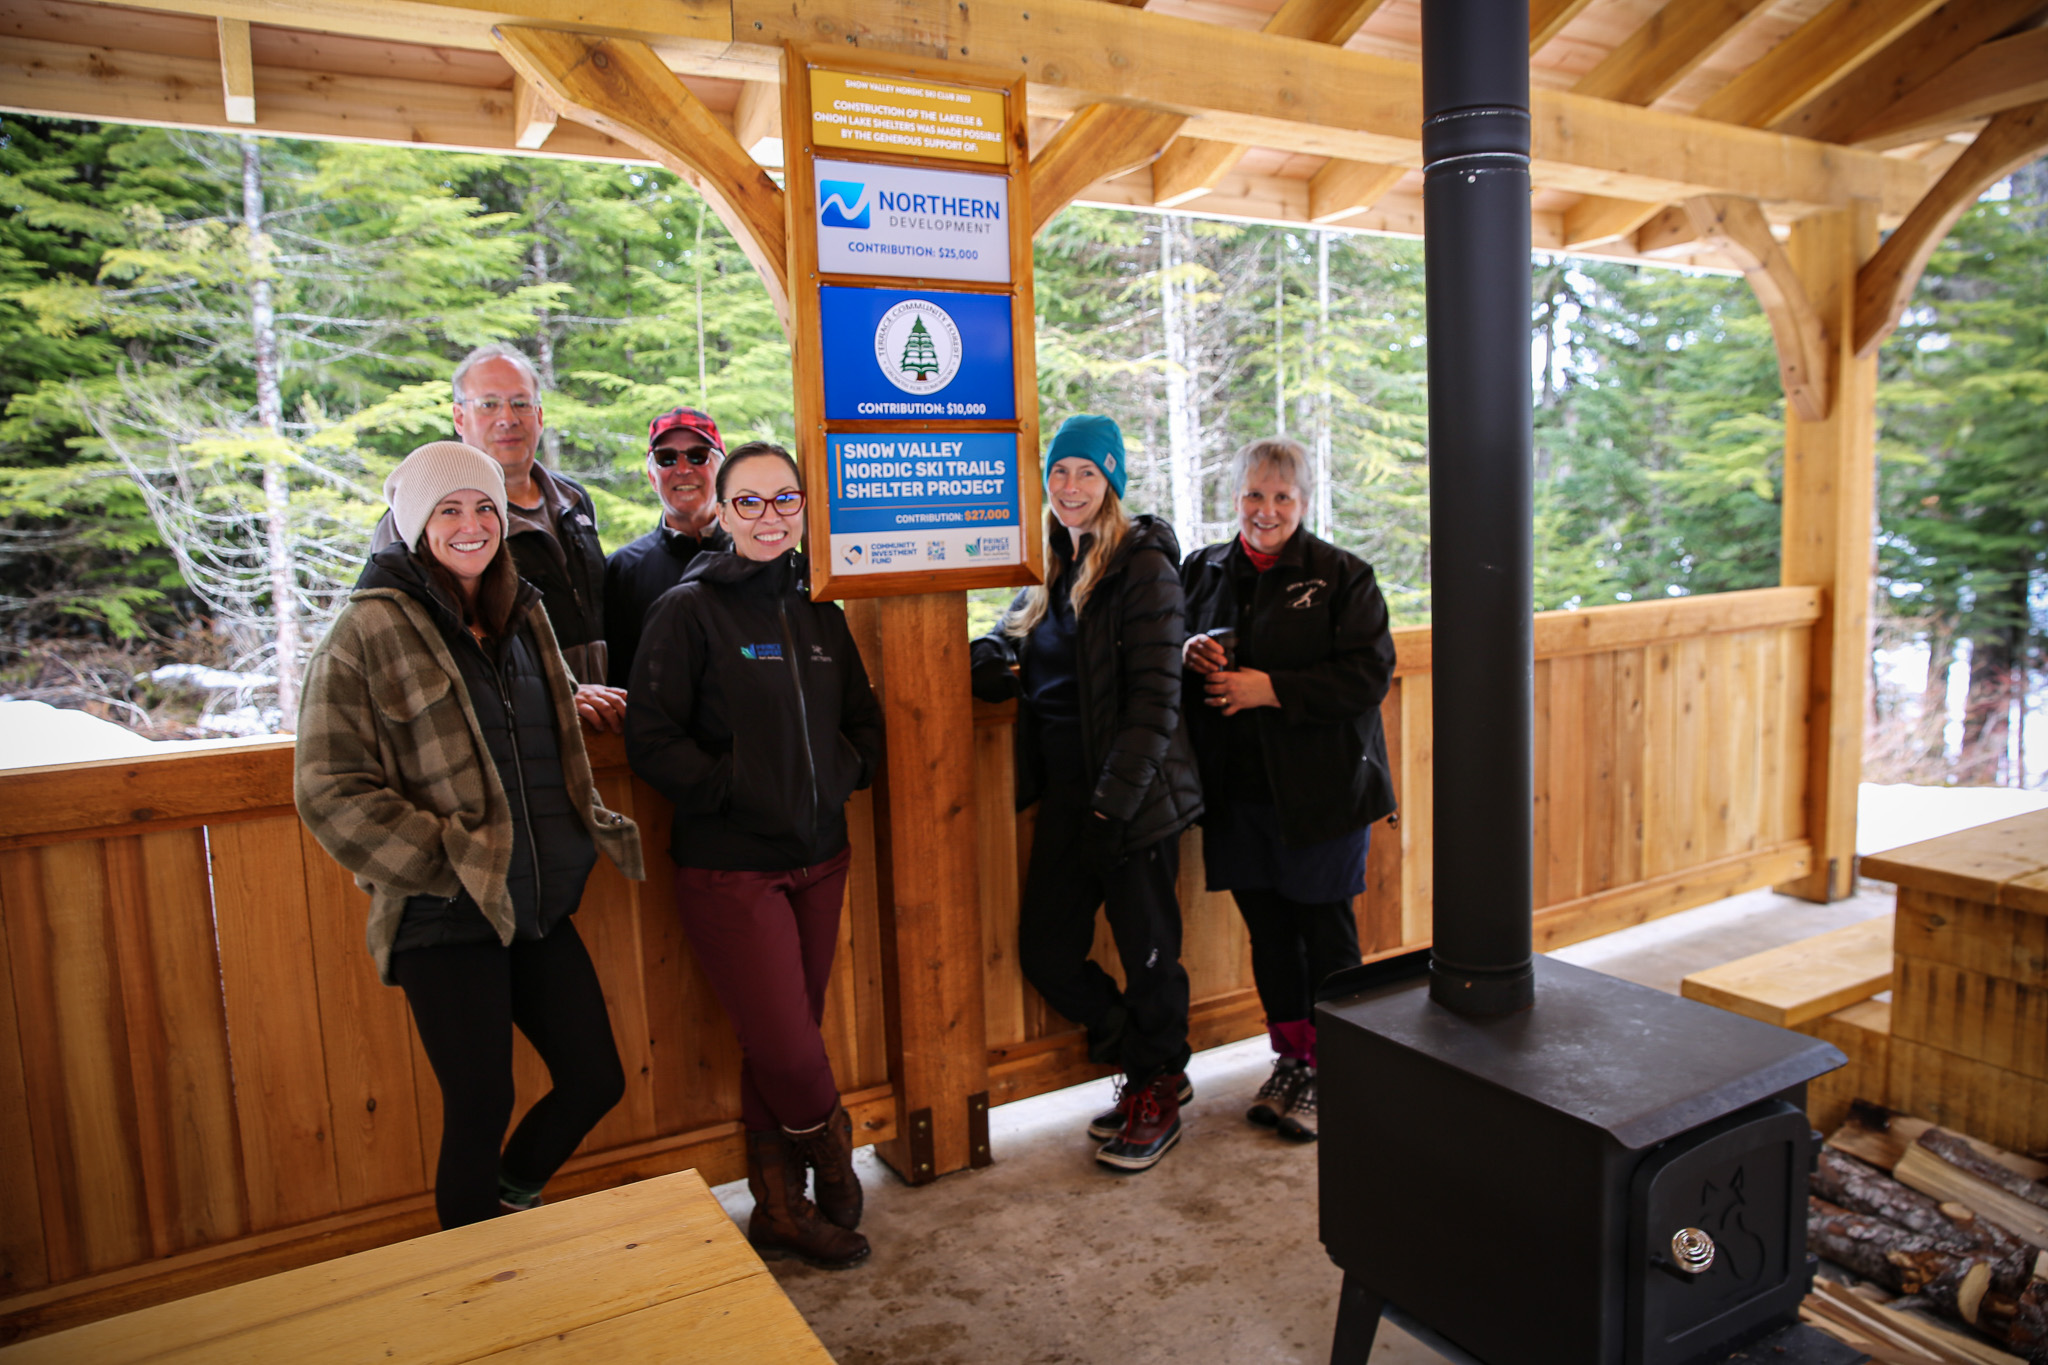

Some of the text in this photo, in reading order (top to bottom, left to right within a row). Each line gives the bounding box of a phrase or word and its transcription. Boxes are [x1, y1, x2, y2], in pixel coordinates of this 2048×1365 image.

[845, 79, 868, 90] SNOW
[870, 82, 894, 93] VALLEY
[895, 86, 924, 98] NORDIC
[924, 90, 936, 99] SKI
[937, 91, 955, 101] CLUB
[833, 100, 984, 127] CONSTRUCTION OF THE LAKELSE &
[813, 112, 1002, 142] ONION LAKE SHELTERS WAS MADE POSSIBLE
[841, 128, 853, 139] BY
[854, 130, 872, 141] THE
[873, 132, 922, 146] GENEROUS
[924, 138, 962, 151] SUPPORT
[879, 190, 1000, 220] NORTHERN
[889, 215, 991, 234] DEVELOPMENT
[848, 242, 979, 260] CONTRIBUTION: $25,000
[892, 302, 946, 322] COMMUNITY
[946, 322, 960, 358] FOREST
[857, 402, 986, 416] CONTRIBUTION: $10,000
[844, 441, 963, 459] SNOW VALLEY
[845, 460, 1006, 479] NORDIC SKI TRAILS
[845, 479, 1004, 499] SHELTER PROJECT
[895, 509, 1010, 524] CONTRIBUTION: $27,000
